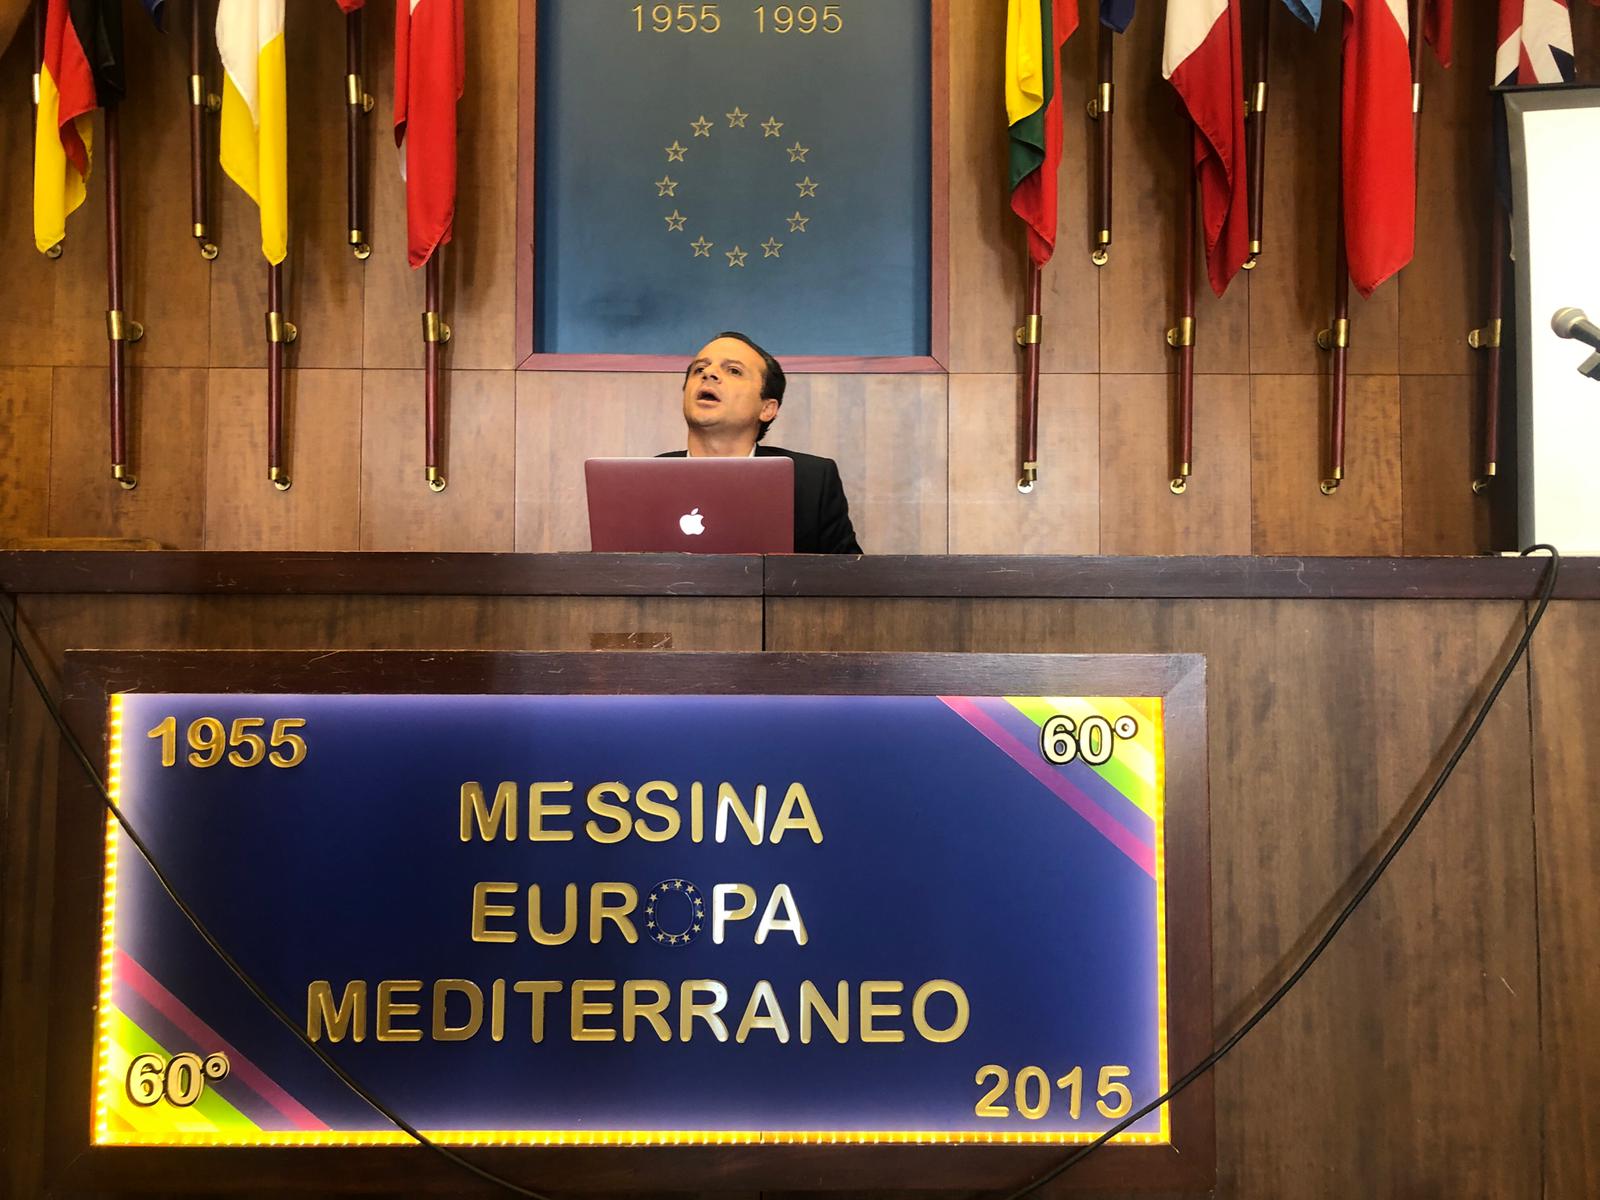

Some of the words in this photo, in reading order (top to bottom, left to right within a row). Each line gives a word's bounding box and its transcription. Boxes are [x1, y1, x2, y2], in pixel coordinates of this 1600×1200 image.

[631, 4, 722, 34] 1955
[753, 4, 844, 34] 1995
[147, 716, 308, 769] 1955
[459, 780, 824, 846] MESSINA
[471, 878, 809, 948] EUROPA
[306, 978, 970, 1045] MEDITERRANEO
[974, 1064, 1134, 1120] 2015
